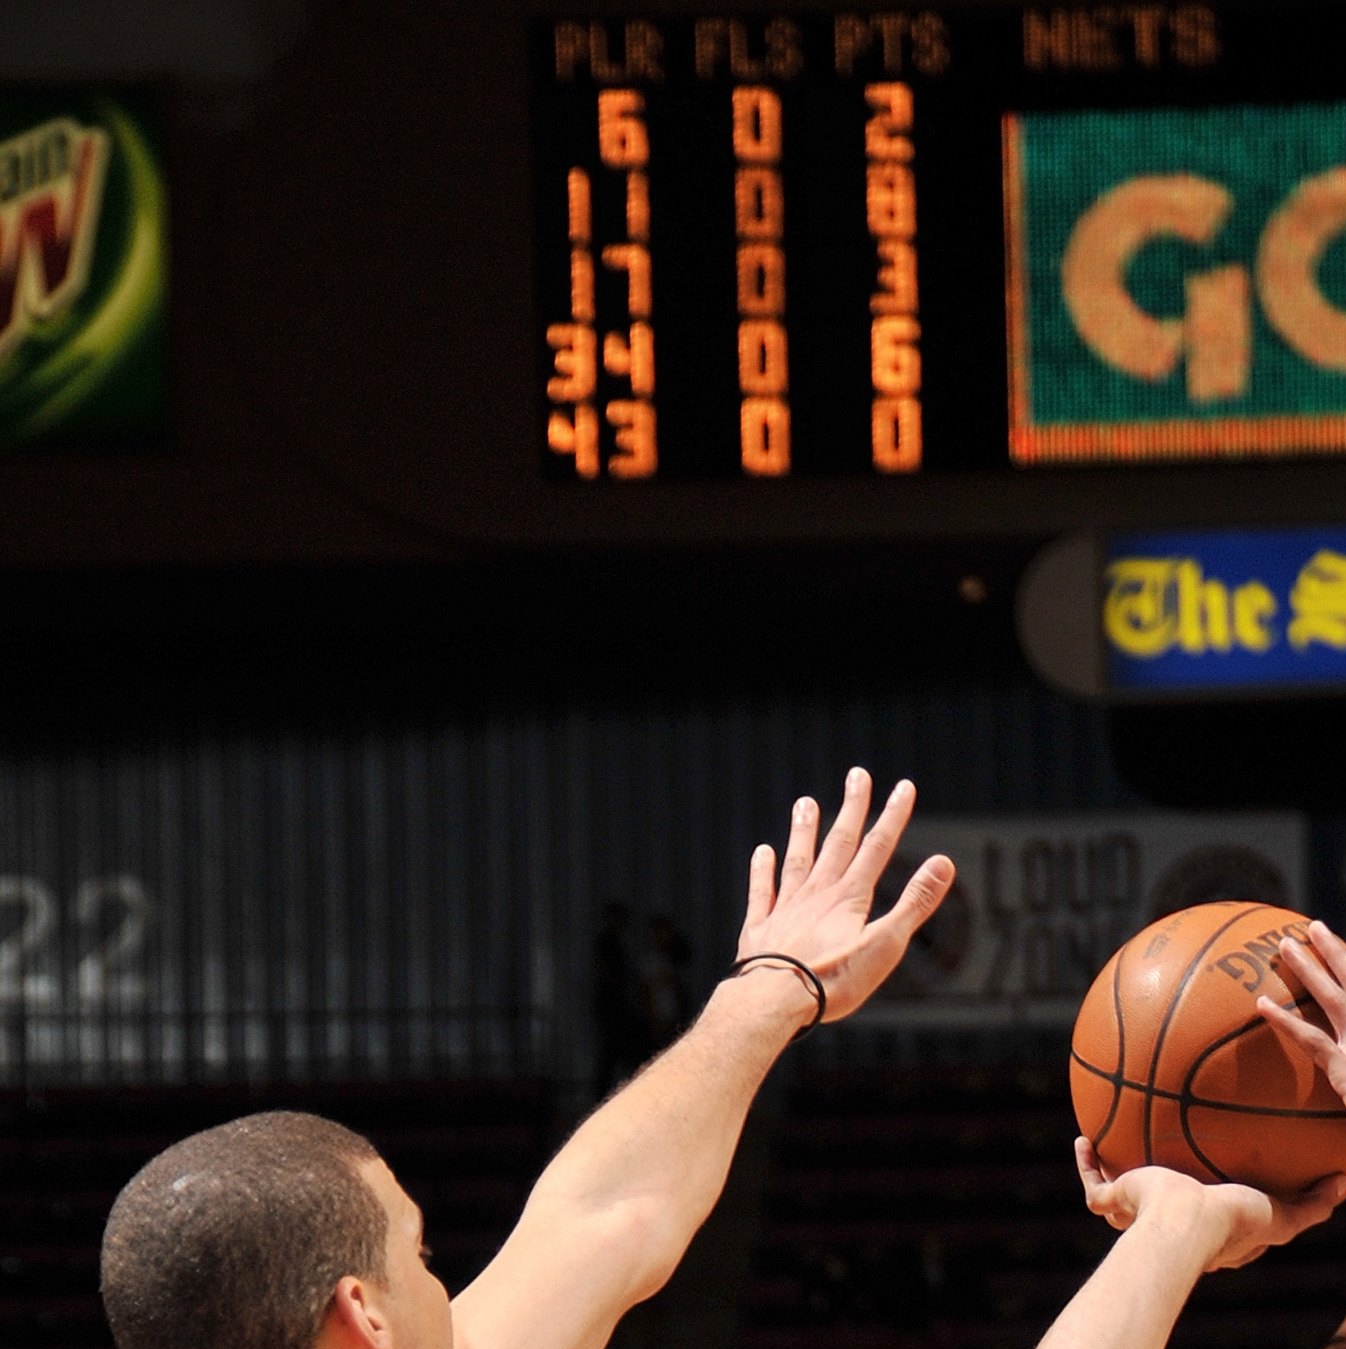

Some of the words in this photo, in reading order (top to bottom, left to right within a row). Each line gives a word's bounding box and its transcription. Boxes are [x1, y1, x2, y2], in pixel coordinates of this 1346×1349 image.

[555, 17, 663, 81] PLR
[834, 12, 949, 78] PTS
[1022, 6, 1220, 69] NETS
[599, 87, 649, 167] 6
[732, 85, 781, 164] 0
[864, 82, 914, 161] 2
[568, 167, 649, 242] 11
[735, 165, 783, 240] 0
[866, 163, 916, 237] 8
[571, 244, 652, 321] 17
[737, 243, 786, 319] 0
[869, 240, 917, 315] 3
[547, 321, 655, 398] 34
[738, 319, 788, 395] 0
[871, 315, 921, 393] 6
[548, 399, 658, 478] 43
[741, 397, 791, 476] 0
[872, 396, 922, 473] 0
[1103, 556, 1276, 658] The
